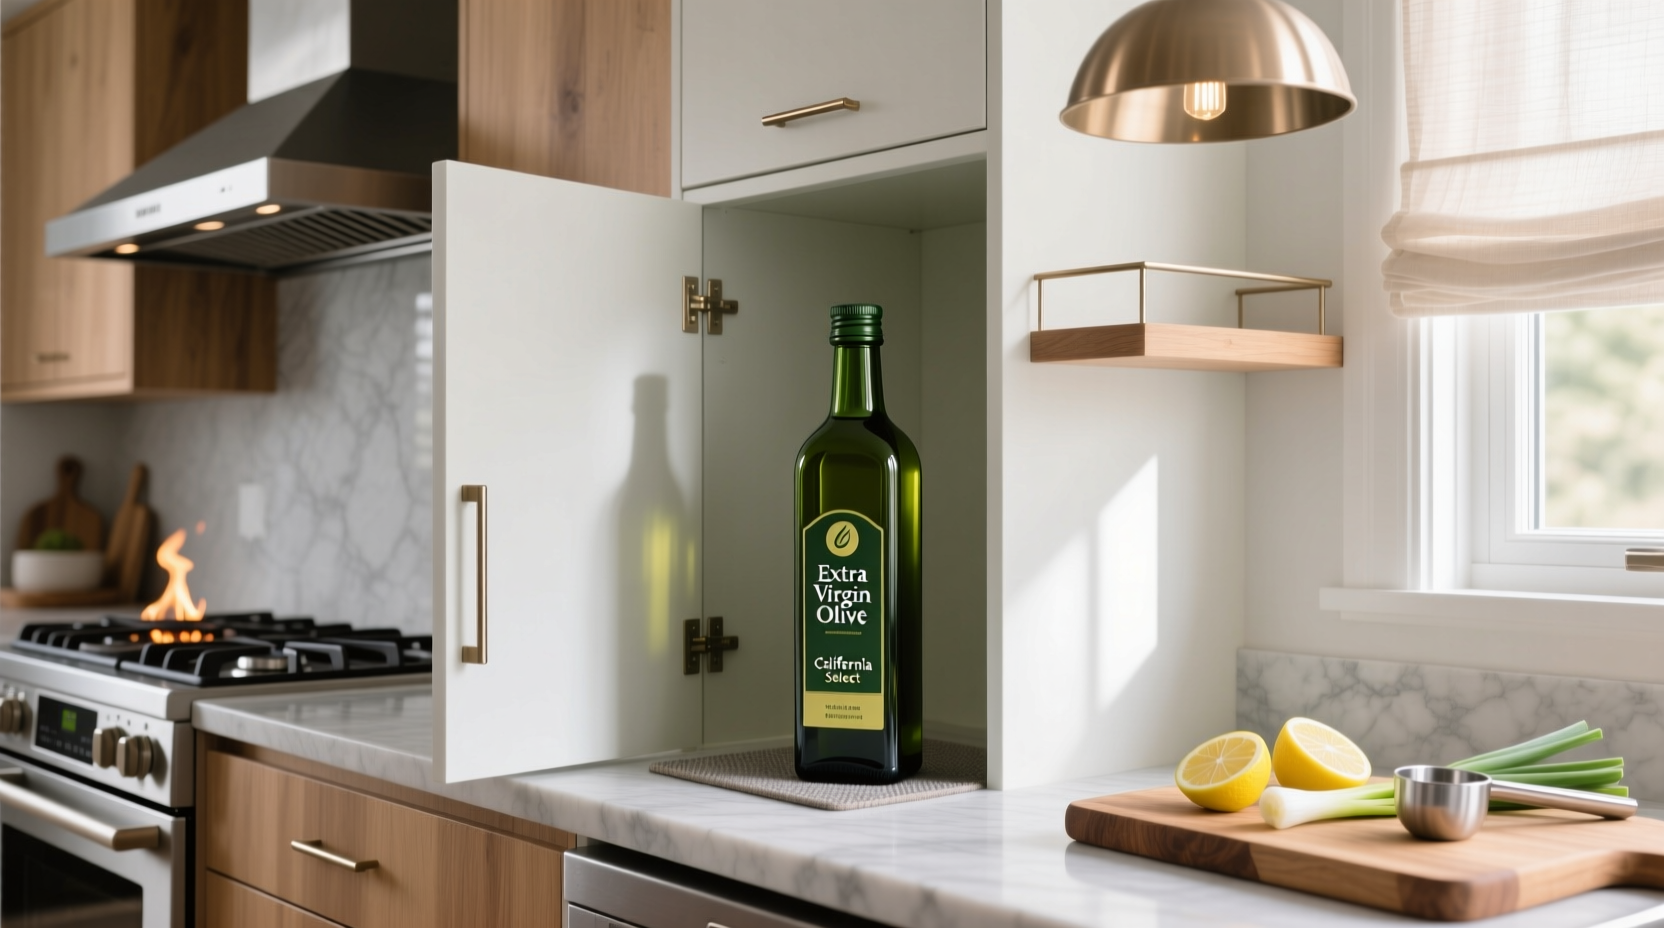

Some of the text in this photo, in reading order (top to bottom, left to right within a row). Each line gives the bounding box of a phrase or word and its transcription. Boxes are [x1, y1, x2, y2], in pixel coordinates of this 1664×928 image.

[817, 564, 868, 582] Extra
[813, 584, 872, 609] Virgin
[816, 605, 867, 625] Olive
[825, 671, 861, 683] Select
